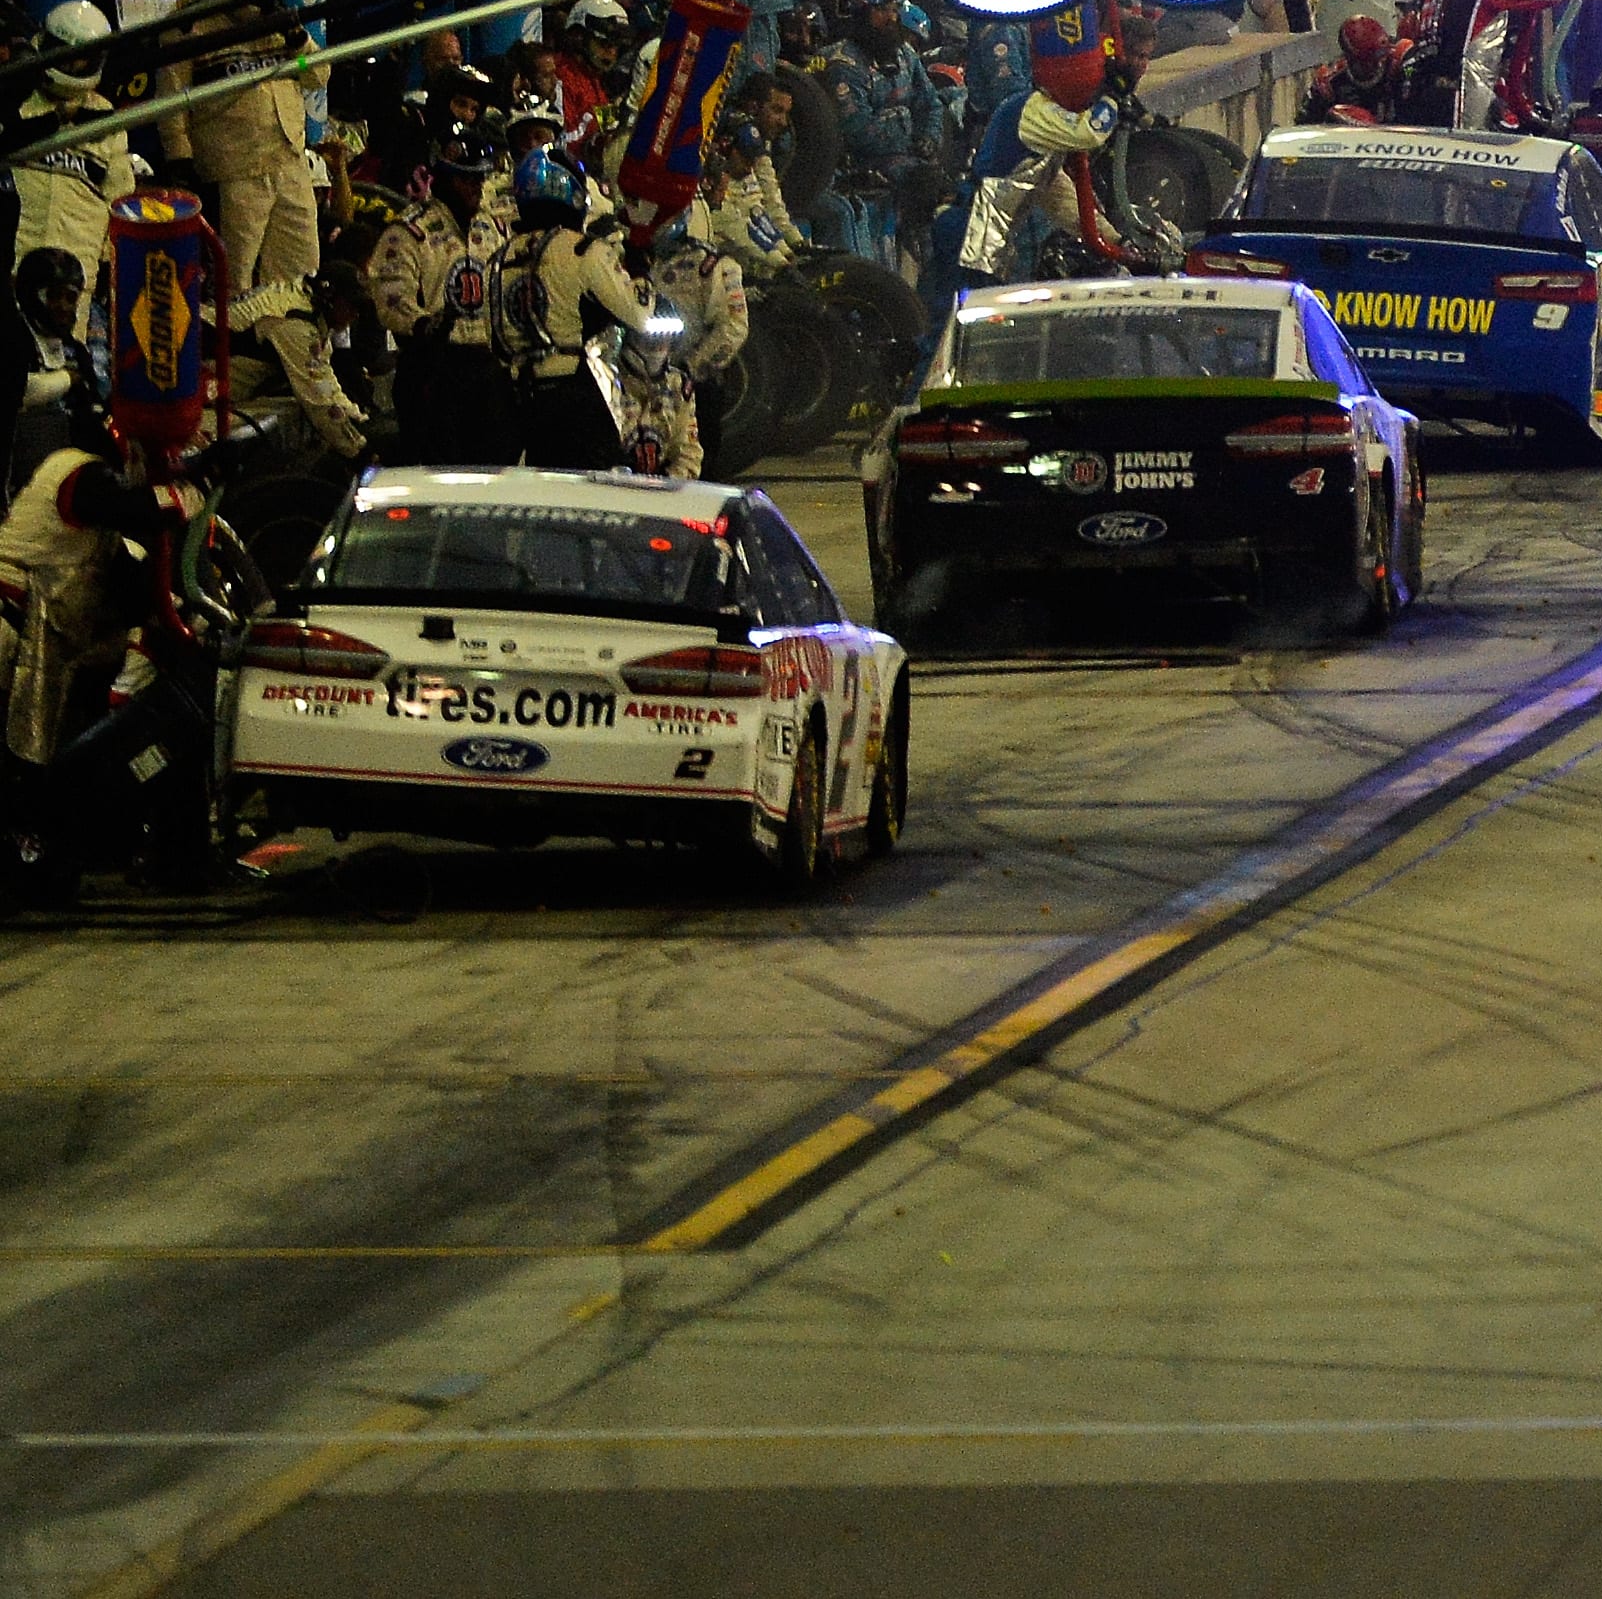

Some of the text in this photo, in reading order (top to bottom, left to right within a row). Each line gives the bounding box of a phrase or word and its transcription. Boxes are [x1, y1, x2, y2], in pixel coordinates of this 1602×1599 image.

[1345, 144, 1441, 160] KNOW
[1452, 148, 1521, 166] HOW
[1334, 290, 1496, 336] KNOW HOW
[1533, 302, 1570, 330] 9
[1356, 346, 1466, 364] MARO
[1114, 451, 1193, 470] JIMMY
[1114, 471, 1196, 493] JOHN'S
[1289, 467, 1326, 495] 4
[263, 685, 375, 707] DISCOUNT
[386, 667, 617, 728] tires.com
[624, 701, 739, 726] AMERICA'S
[460, 739, 532, 772] Ford
[674, 748, 715, 780] 2
